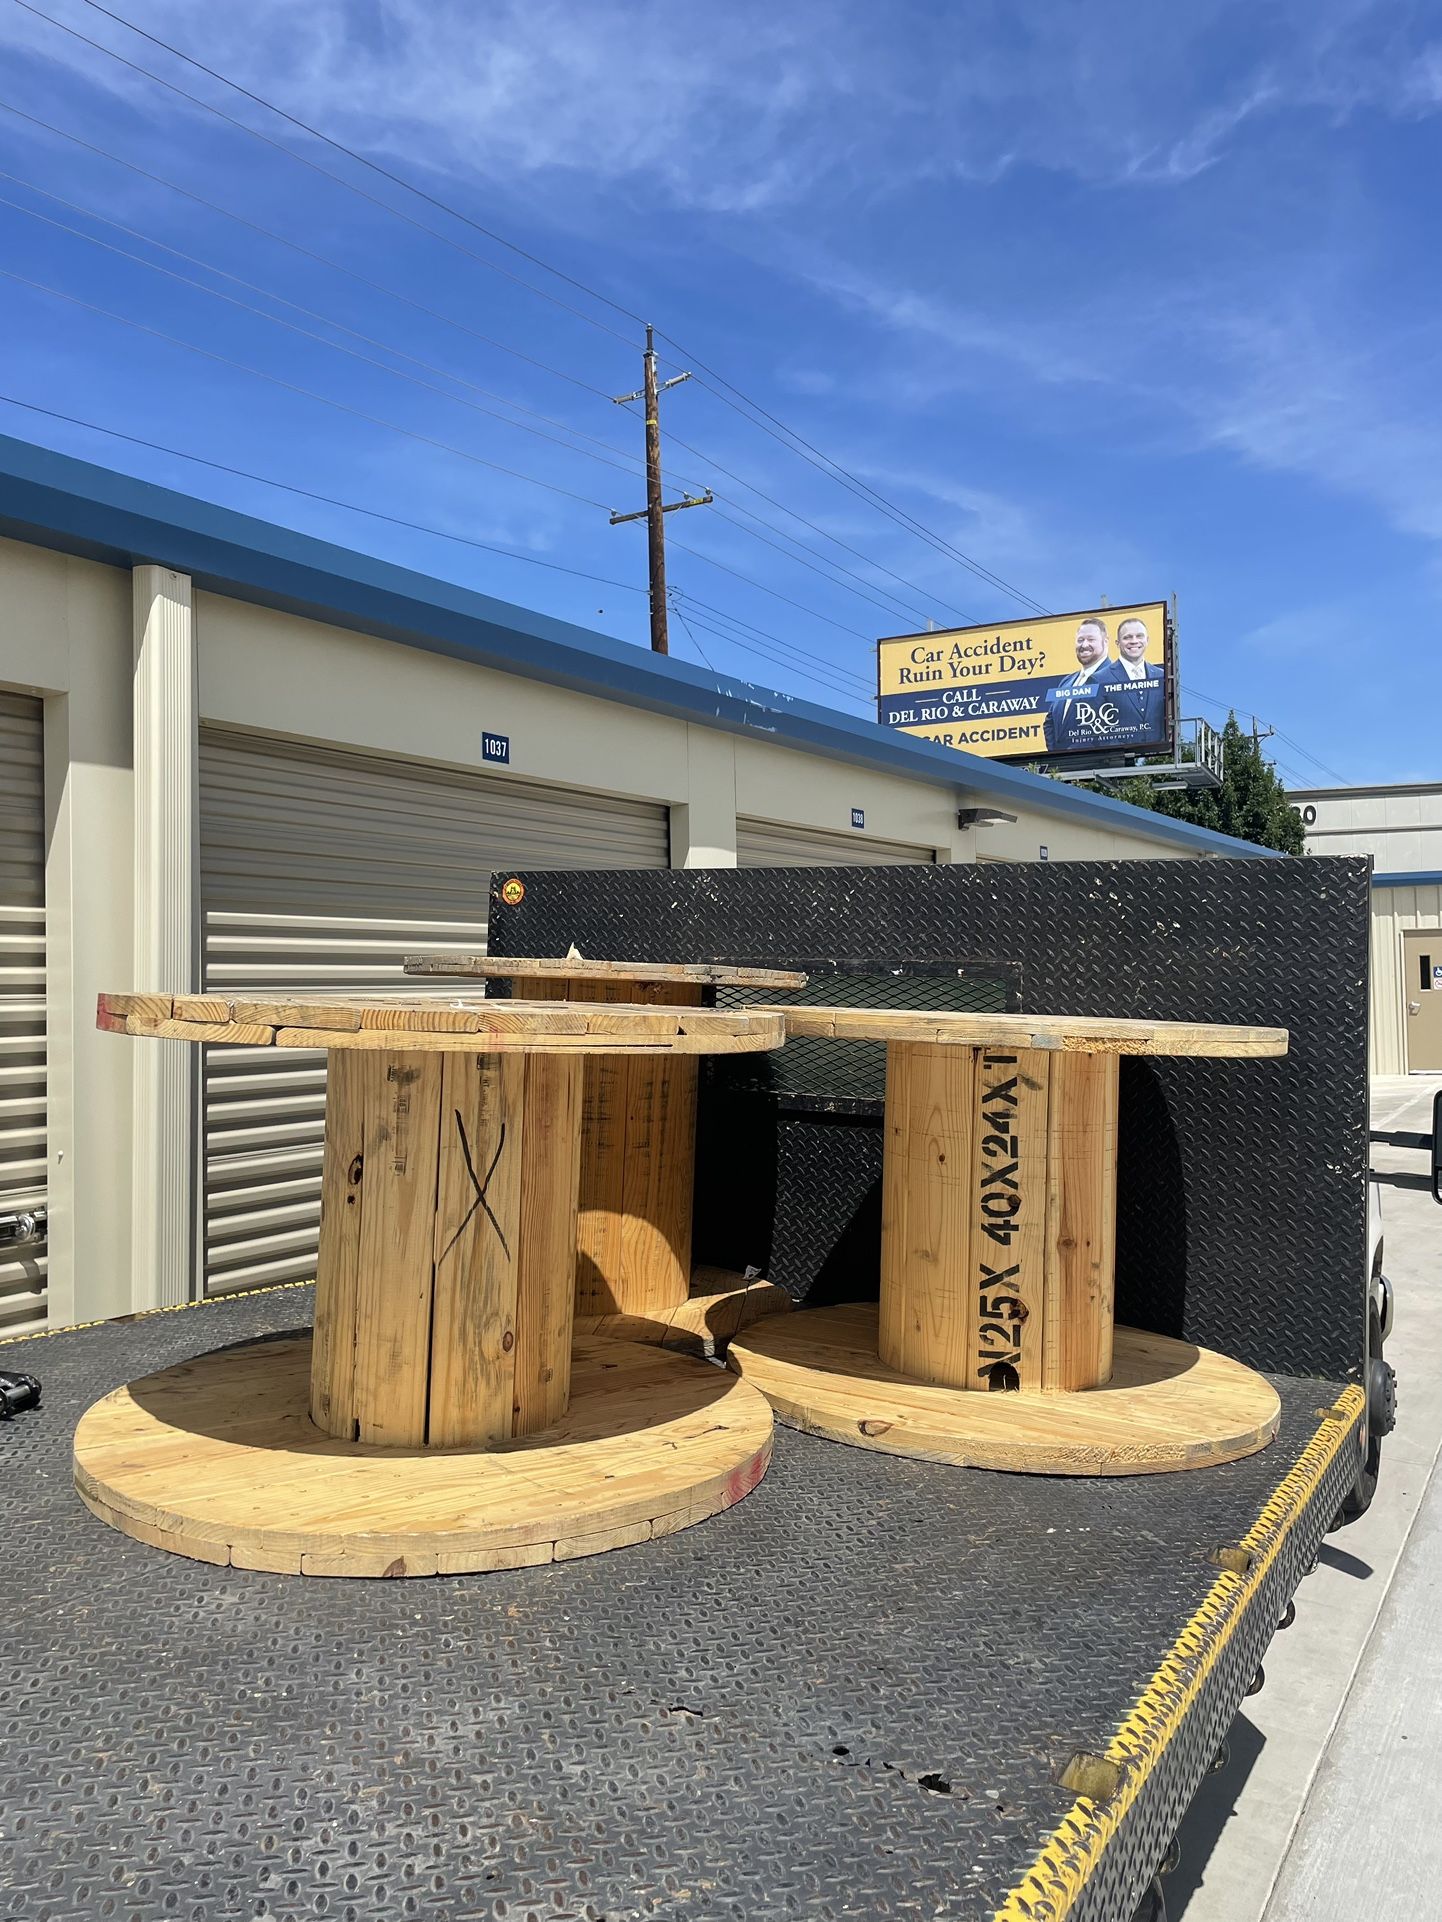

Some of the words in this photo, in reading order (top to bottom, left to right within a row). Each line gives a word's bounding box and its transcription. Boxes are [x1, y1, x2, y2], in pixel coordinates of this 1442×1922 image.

[911, 647, 944, 664] Car
[948, 636, 1033, 660] Accident
[898, 666, 943, 684] Ruin
[948, 660, 992, 679] Your
[999, 651, 1046, 675] Day?
[1055, 689, 1071, 698] BIG
[1072, 687, 1091, 696] DAN
[1104, 684, 1122, 692] THE
[1123, 680, 1159, 690] MARINE
[942, 689, 981, 704] CALL
[889, 710, 918, 724] DEL
[921, 706, 948, 721] RIO
[952, 705, 965, 718] &
[968, 696, 1040, 715] CARAWAY
[922, 734, 953, 746] AR
[958, 725, 1041, 745] ACCIDENT
[485, 738, 507, 757] 1037
